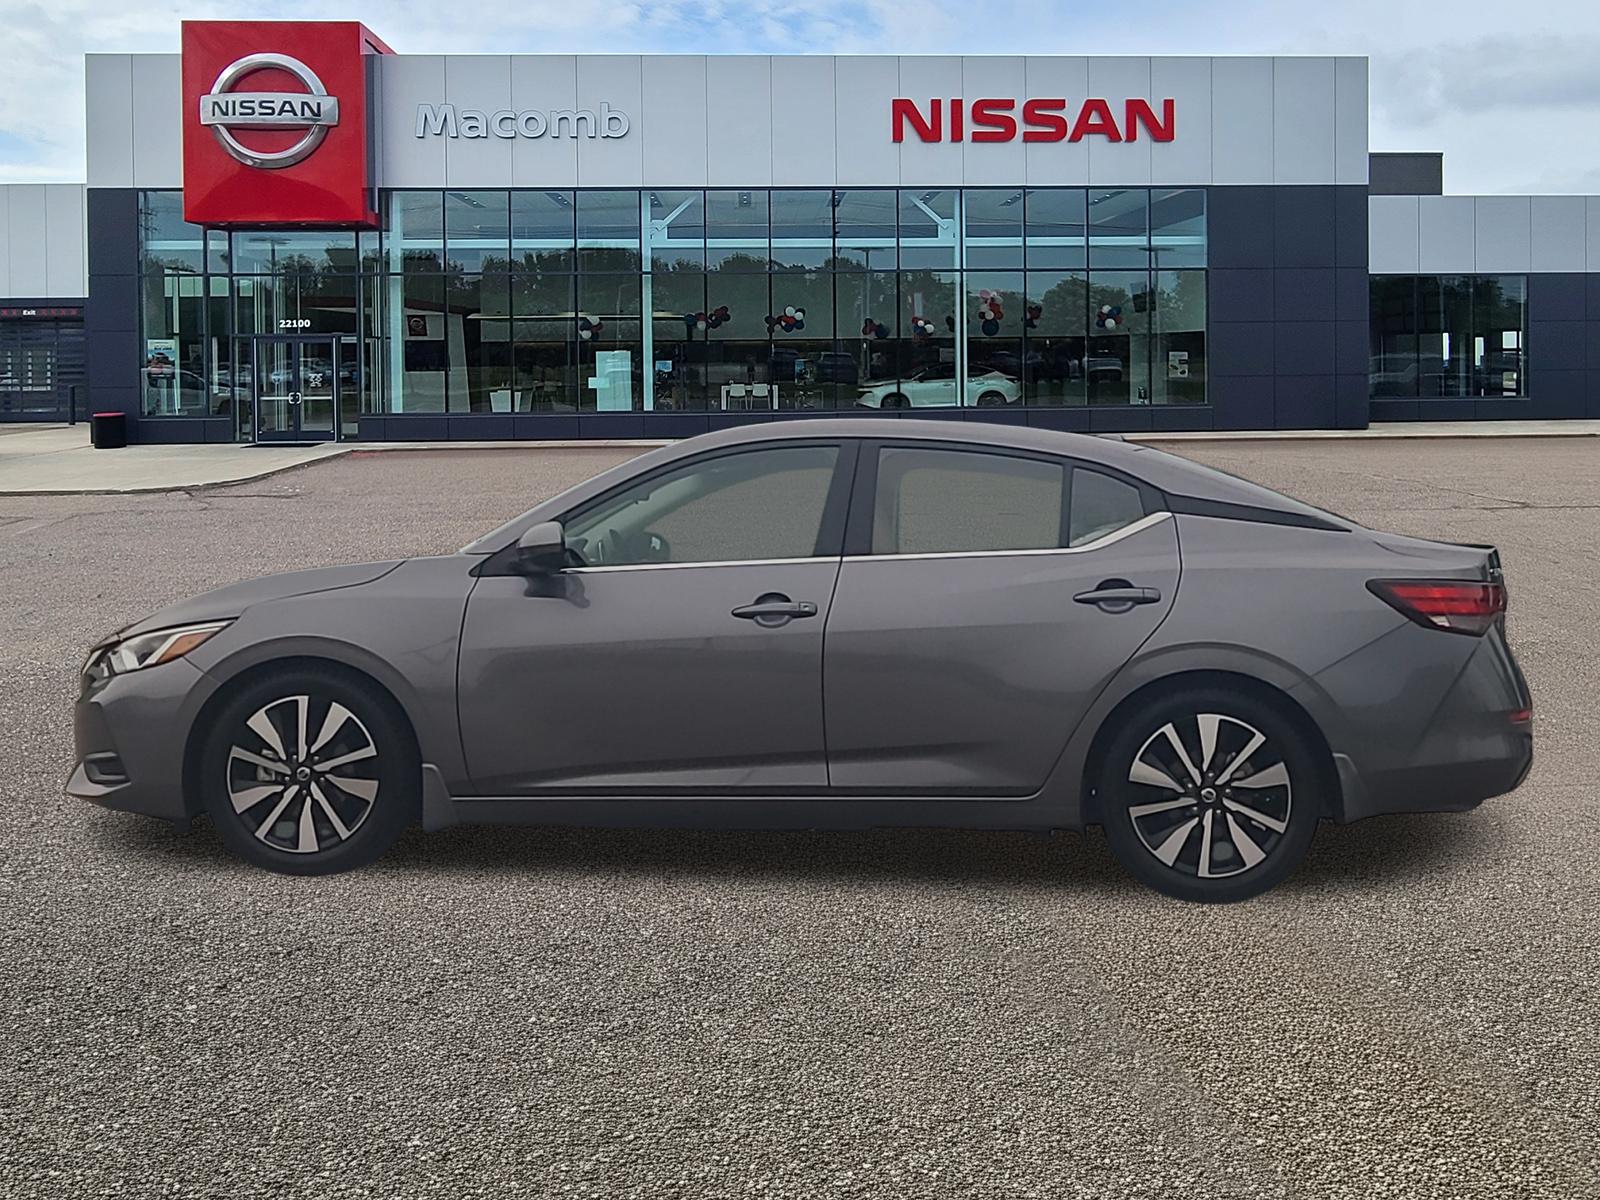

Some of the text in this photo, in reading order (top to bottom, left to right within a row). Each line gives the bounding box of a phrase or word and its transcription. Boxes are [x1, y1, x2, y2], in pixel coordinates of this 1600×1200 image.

[212, 100, 321, 117] NISSAN
[415, 102, 630, 138] Macomb
[892, 98, 1175, 143] NISSAN
[279, 319, 311, 328] 22100
